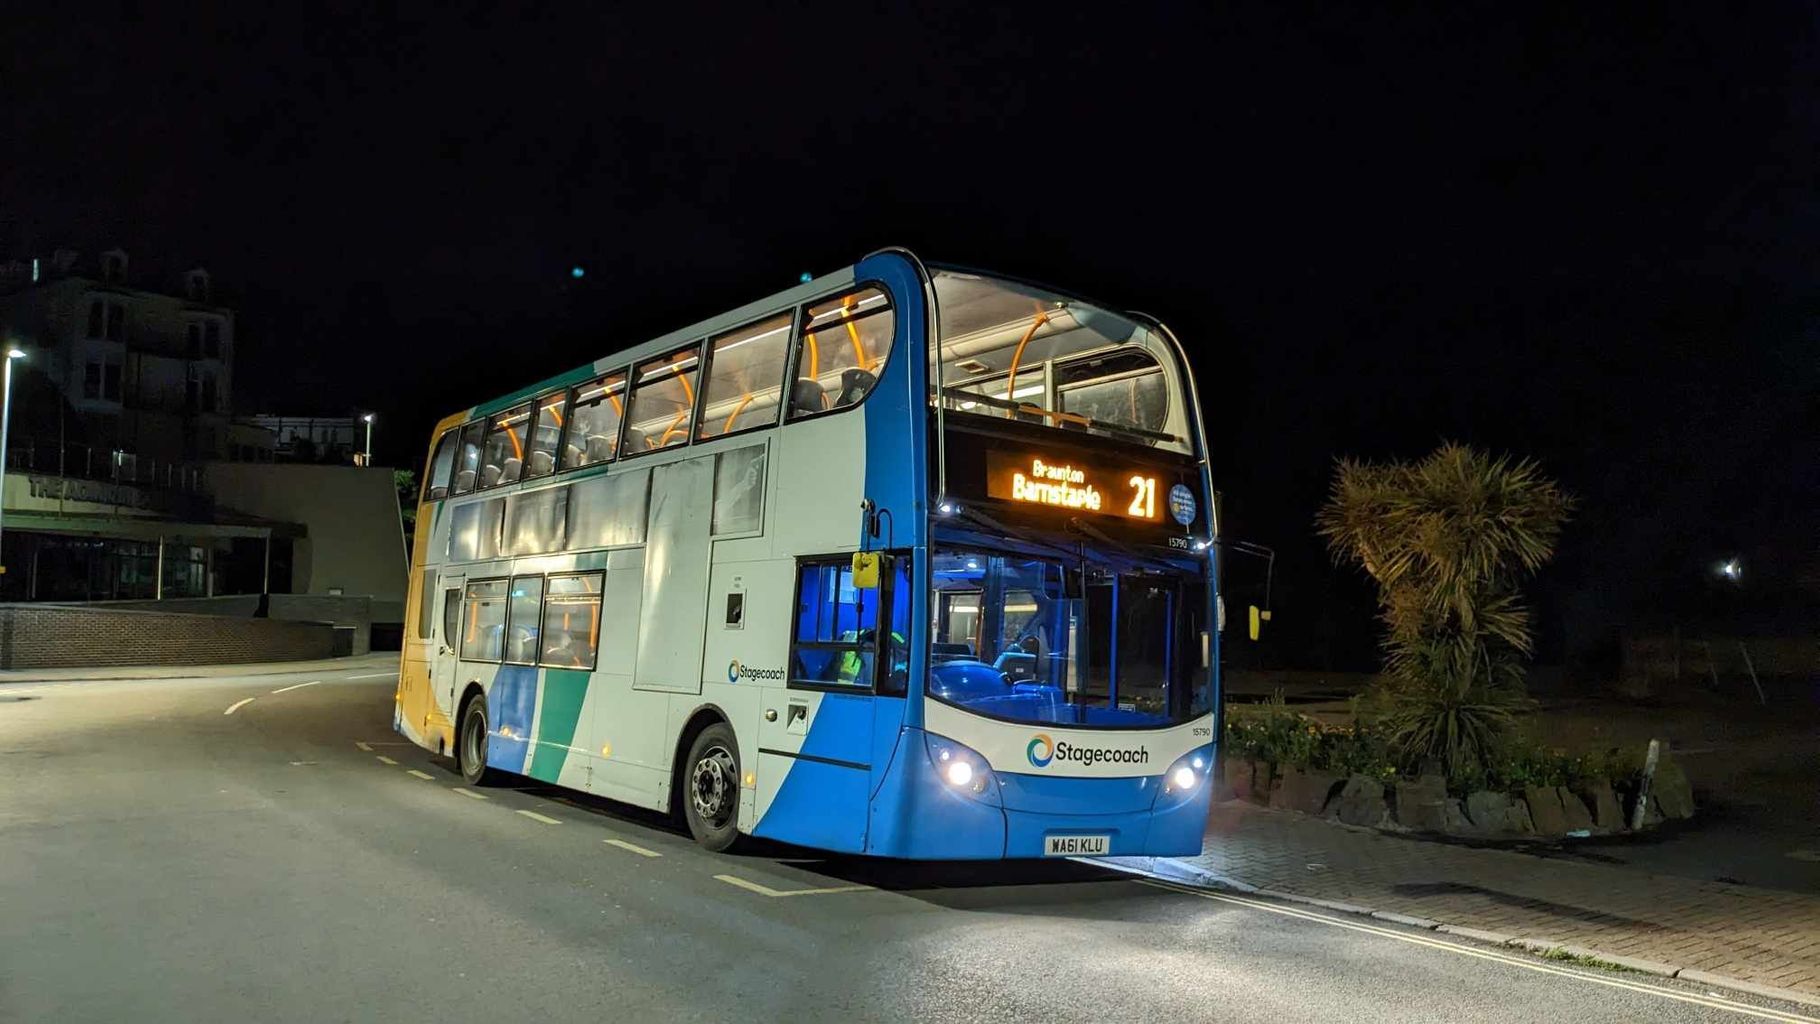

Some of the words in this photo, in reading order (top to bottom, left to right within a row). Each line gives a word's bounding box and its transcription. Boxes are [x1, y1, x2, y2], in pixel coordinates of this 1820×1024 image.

[1033, 459, 1084, 483] Braunton
[1012, 473, 1101, 510] Barnstaple
[1128, 475, 1156, 518] 21
[1168, 537, 1188, 548] 15790
[740, 664, 785, 681] Stagecoach
[1192, 727, 1210, 736] 15790
[1056, 742, 1149, 766] Stagecoach
[1052, 838, 1078, 852] WA61
[1081, 838, 1103, 852] KLU
